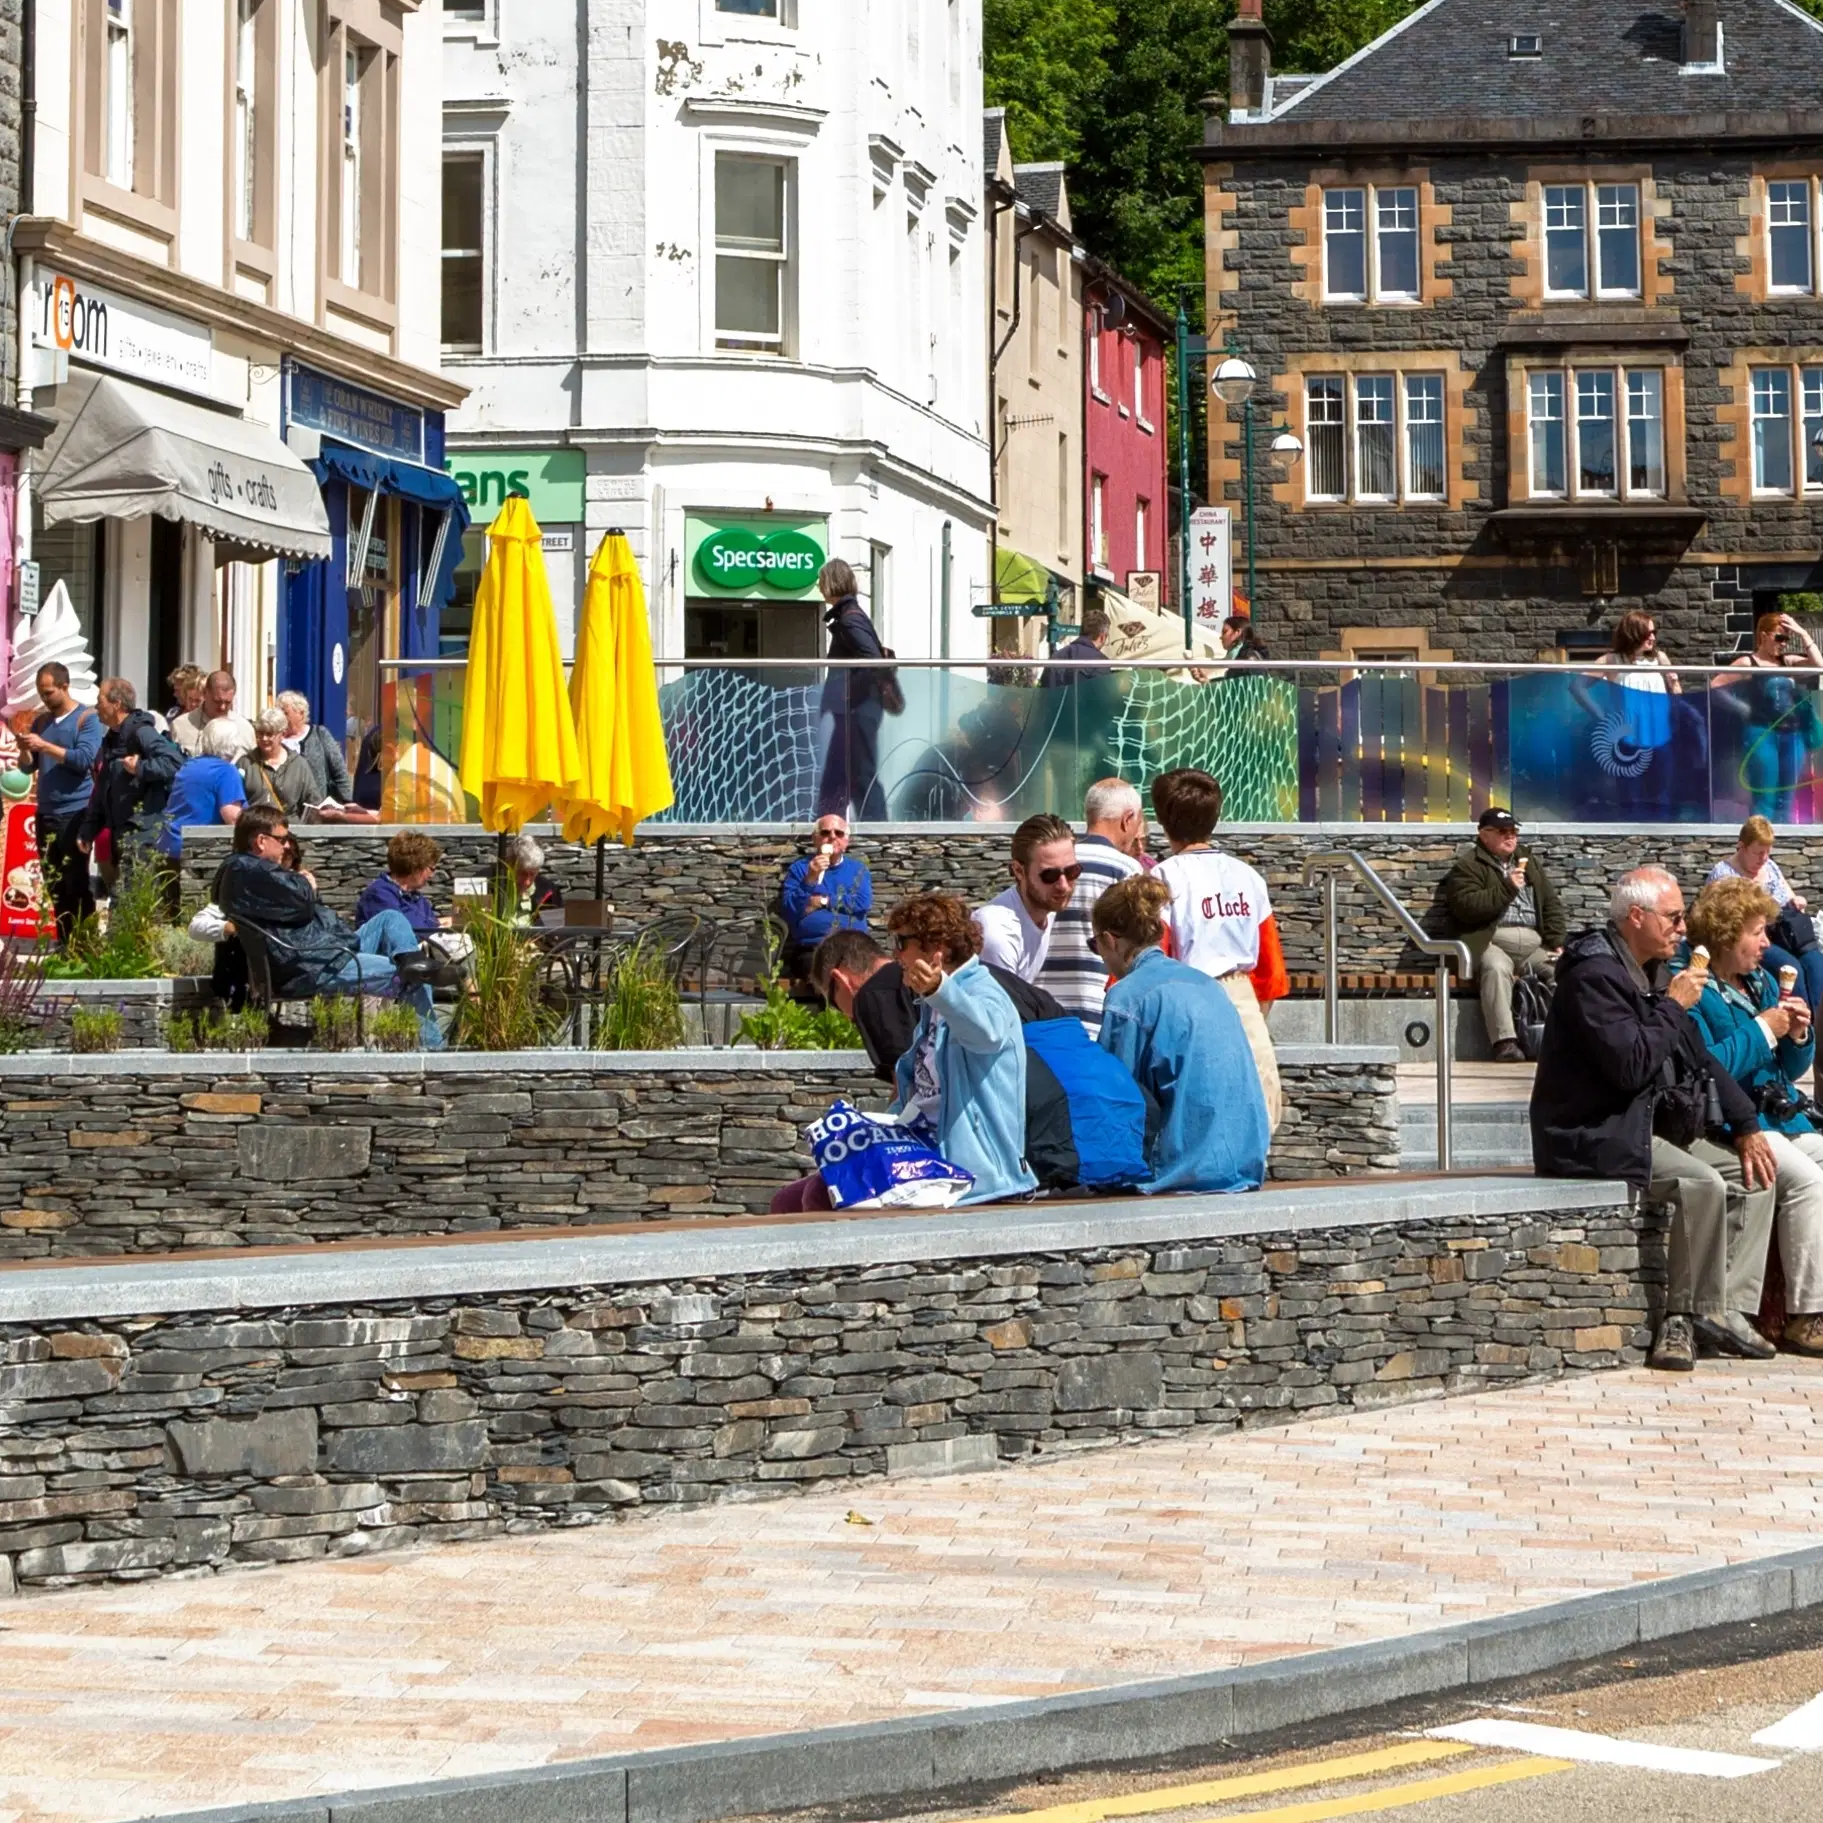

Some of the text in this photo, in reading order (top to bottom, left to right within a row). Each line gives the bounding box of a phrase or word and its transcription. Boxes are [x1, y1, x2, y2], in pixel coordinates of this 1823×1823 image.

[208, 460, 277, 511] gifts crafts
[712, 545, 815, 572] Specsavers
[1202, 892, 1250, 919] Clock
